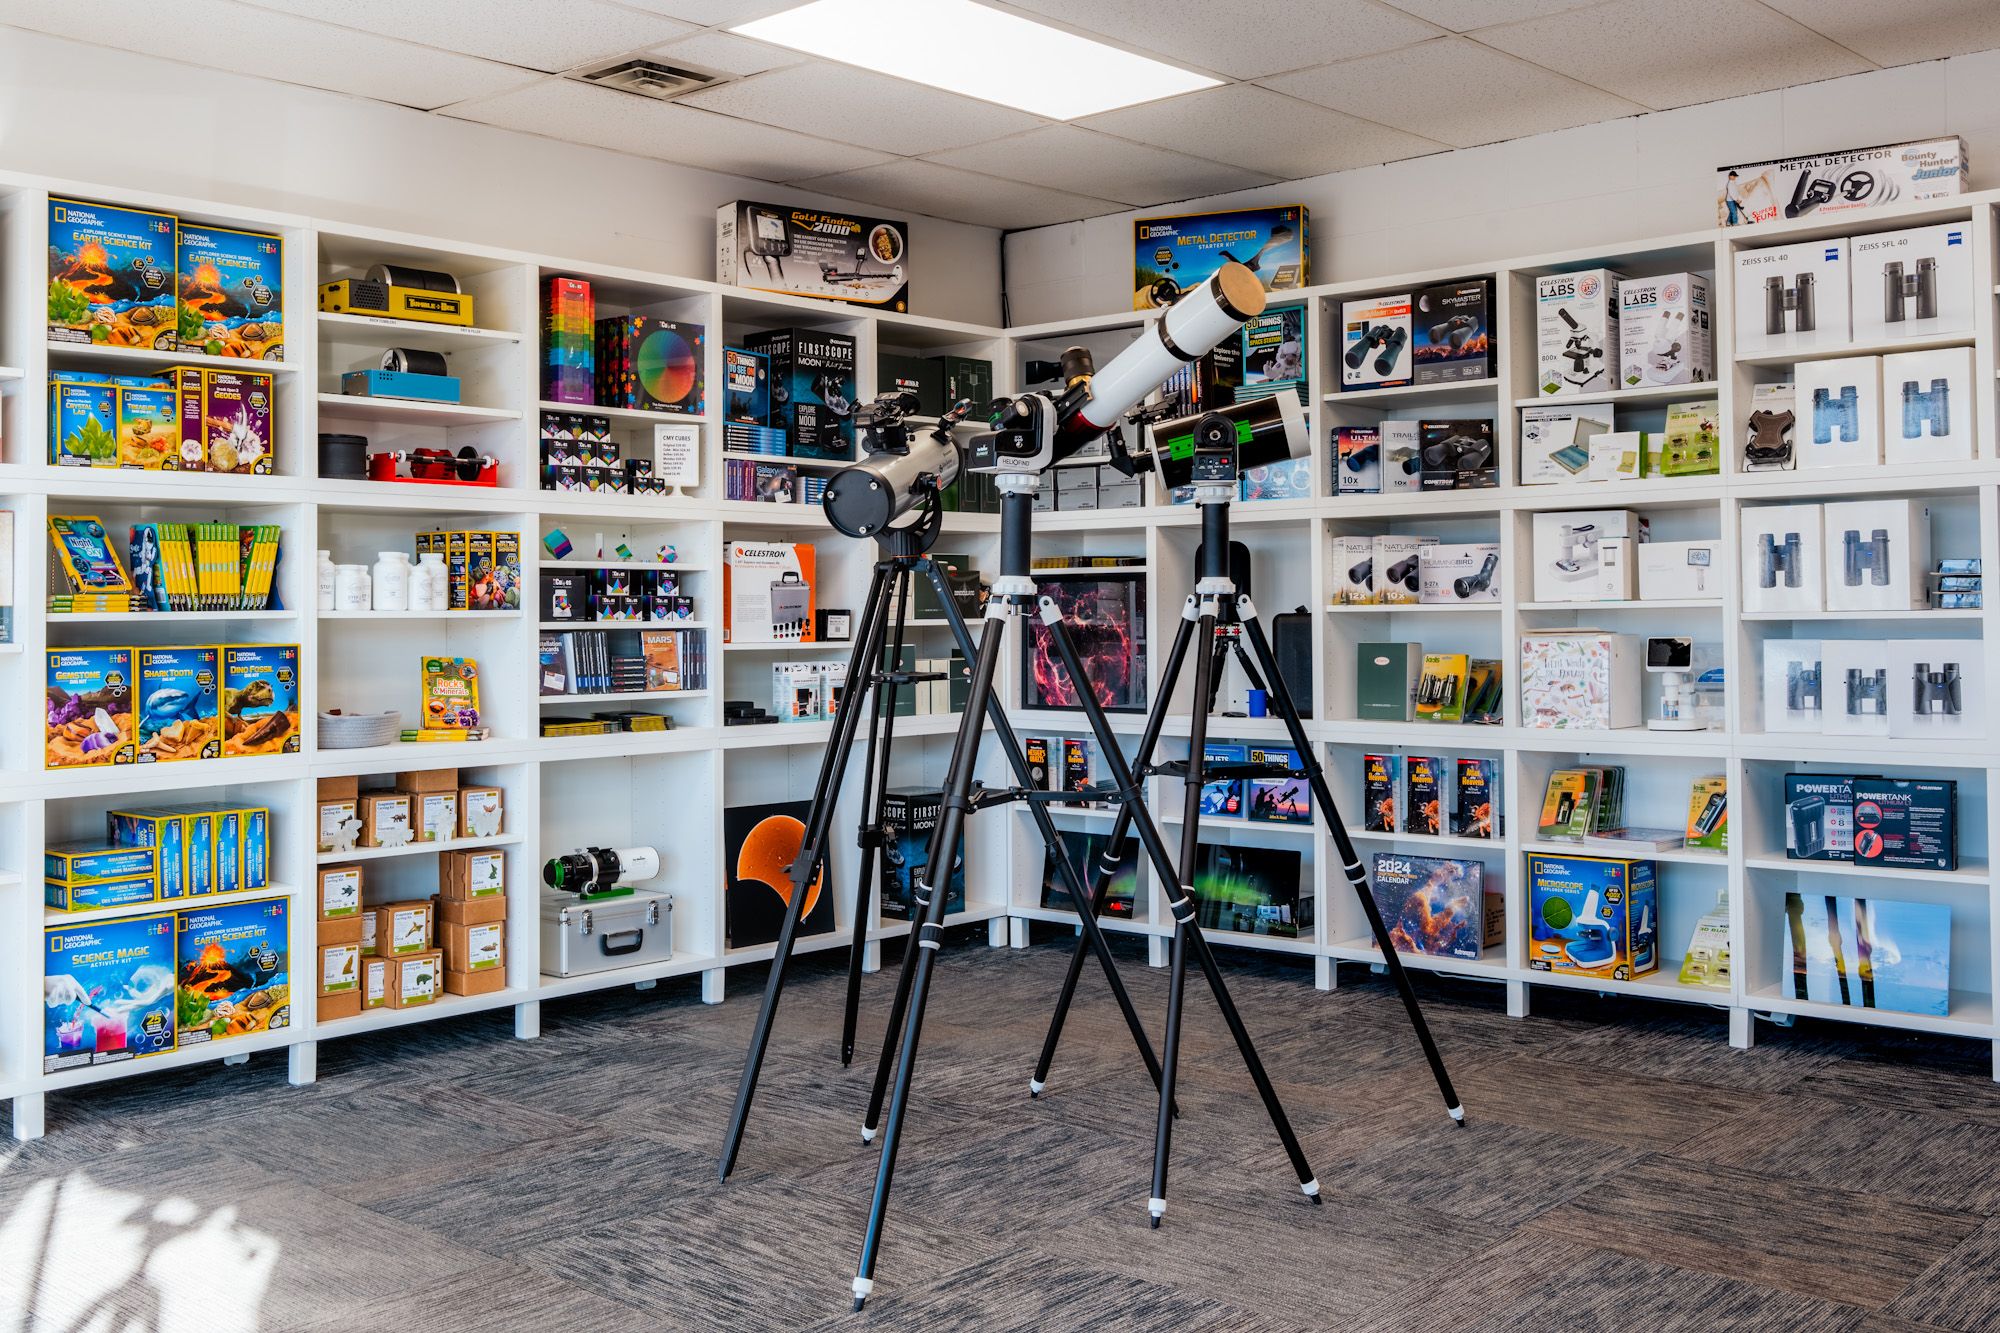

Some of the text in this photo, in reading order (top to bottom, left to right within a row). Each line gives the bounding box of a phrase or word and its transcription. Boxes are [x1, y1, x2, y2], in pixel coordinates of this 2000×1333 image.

[1780, 150, 1892, 172] METAL DETECTOR
[1902, 152, 1936, 162] Bounty
[1920, 158, 1954, 168] Hunter
[1912, 166, 1960, 181] Junior
[67, 210, 97, 220] NATIONAL
[1752, 206, 1773, 218] SUPER
[67, 217, 104, 227] GEOGRAPHIC
[792, 212, 855, 226] Gold Finder
[813, 222, 850, 236] 2000
[1150, 230, 1178, 238] GEOGRAPHIC
[72, 232, 152, 250] EARTH SCIENCE KIT
[184, 233, 210, 242] NATIONAL
[1177, 230, 1257, 246] METAL DETECTOR
[184, 240, 218, 248] GEOGRAPHIC
[1858, 238, 1908, 251] ZEISS SFL 40
[188, 254, 261, 270] EARTH SCIENCE KIT
[1742, 254, 1788, 266] ZEISS SFL 40
[1540, 278, 1575, 286] CELESTRON
[1540, 284, 1576, 298] LABS
[1624, 286, 1657, 294] CELESTRON
[1692, 288, 1706, 302] LABS
[1442, 294, 1481, 306] SKYMASTER
[1624, 292, 1657, 306] LABS
[1246, 316, 1282, 328] 50 THINGS
[1250, 336, 1282, 346] SPACE STATION
[798, 342, 853, 360] FIRSTSCOPE
[1214, 346, 1231, 355] Explore
[736, 356, 755, 368] THINGS
[798, 357, 822, 368] MOON
[1214, 354, 1234, 362] Universe
[730, 364, 736, 372] TO
[737, 365, 746, 374] SEE
[736, 374, 755, 386] MOON
[214, 391, 242, 400] GEODES
[798, 405, 816, 414] EXPLORE
[798, 416, 816, 426] MOON
[756, 466, 778, 474] Galaxy
[1343, 476, 1358, 484] 10x
[69, 537, 92, 548] Night
[86, 547, 102, 558] Sky
[744, 550, 786, 558] CELESTRON
[648, 636, 672, 644] MARS
[144, 669, 193, 678] SHARK TOOTH
[230, 665, 274, 674] DINO FOSSIL
[56, 671, 101, 680] GEMSTONE
[437, 678, 464, 688] Rocks
[1252, 752, 1288, 763] 50 THINGS
[1796, 784, 1852, 794] POWERTA
[1856, 792, 1912, 800] POWERTANK
[913, 804, 942, 819] FIRSTS
[913, 820, 935, 830] MOON
[1377, 860, 1410, 874] 2024
[1377, 875, 1410, 884] CALENDAR
[1537, 878, 1584, 890] MICROSCOPE
[1630, 880, 1654, 891] MICROSCOPE
[189, 915, 216, 924] NATIONAL
[189, 920, 223, 930] GEOGRAPHIC
[65, 934, 94, 942] NATIONAL
[194, 928, 267, 946] EARTH SCIENCE KIT
[64, 940, 102, 949] GEOGRAPHIC
[72, 946, 150, 965] SCIENCE MAGIC
[90, 960, 120, 968] ACTIVITY
[146, 1014, 162, 1026] 25
